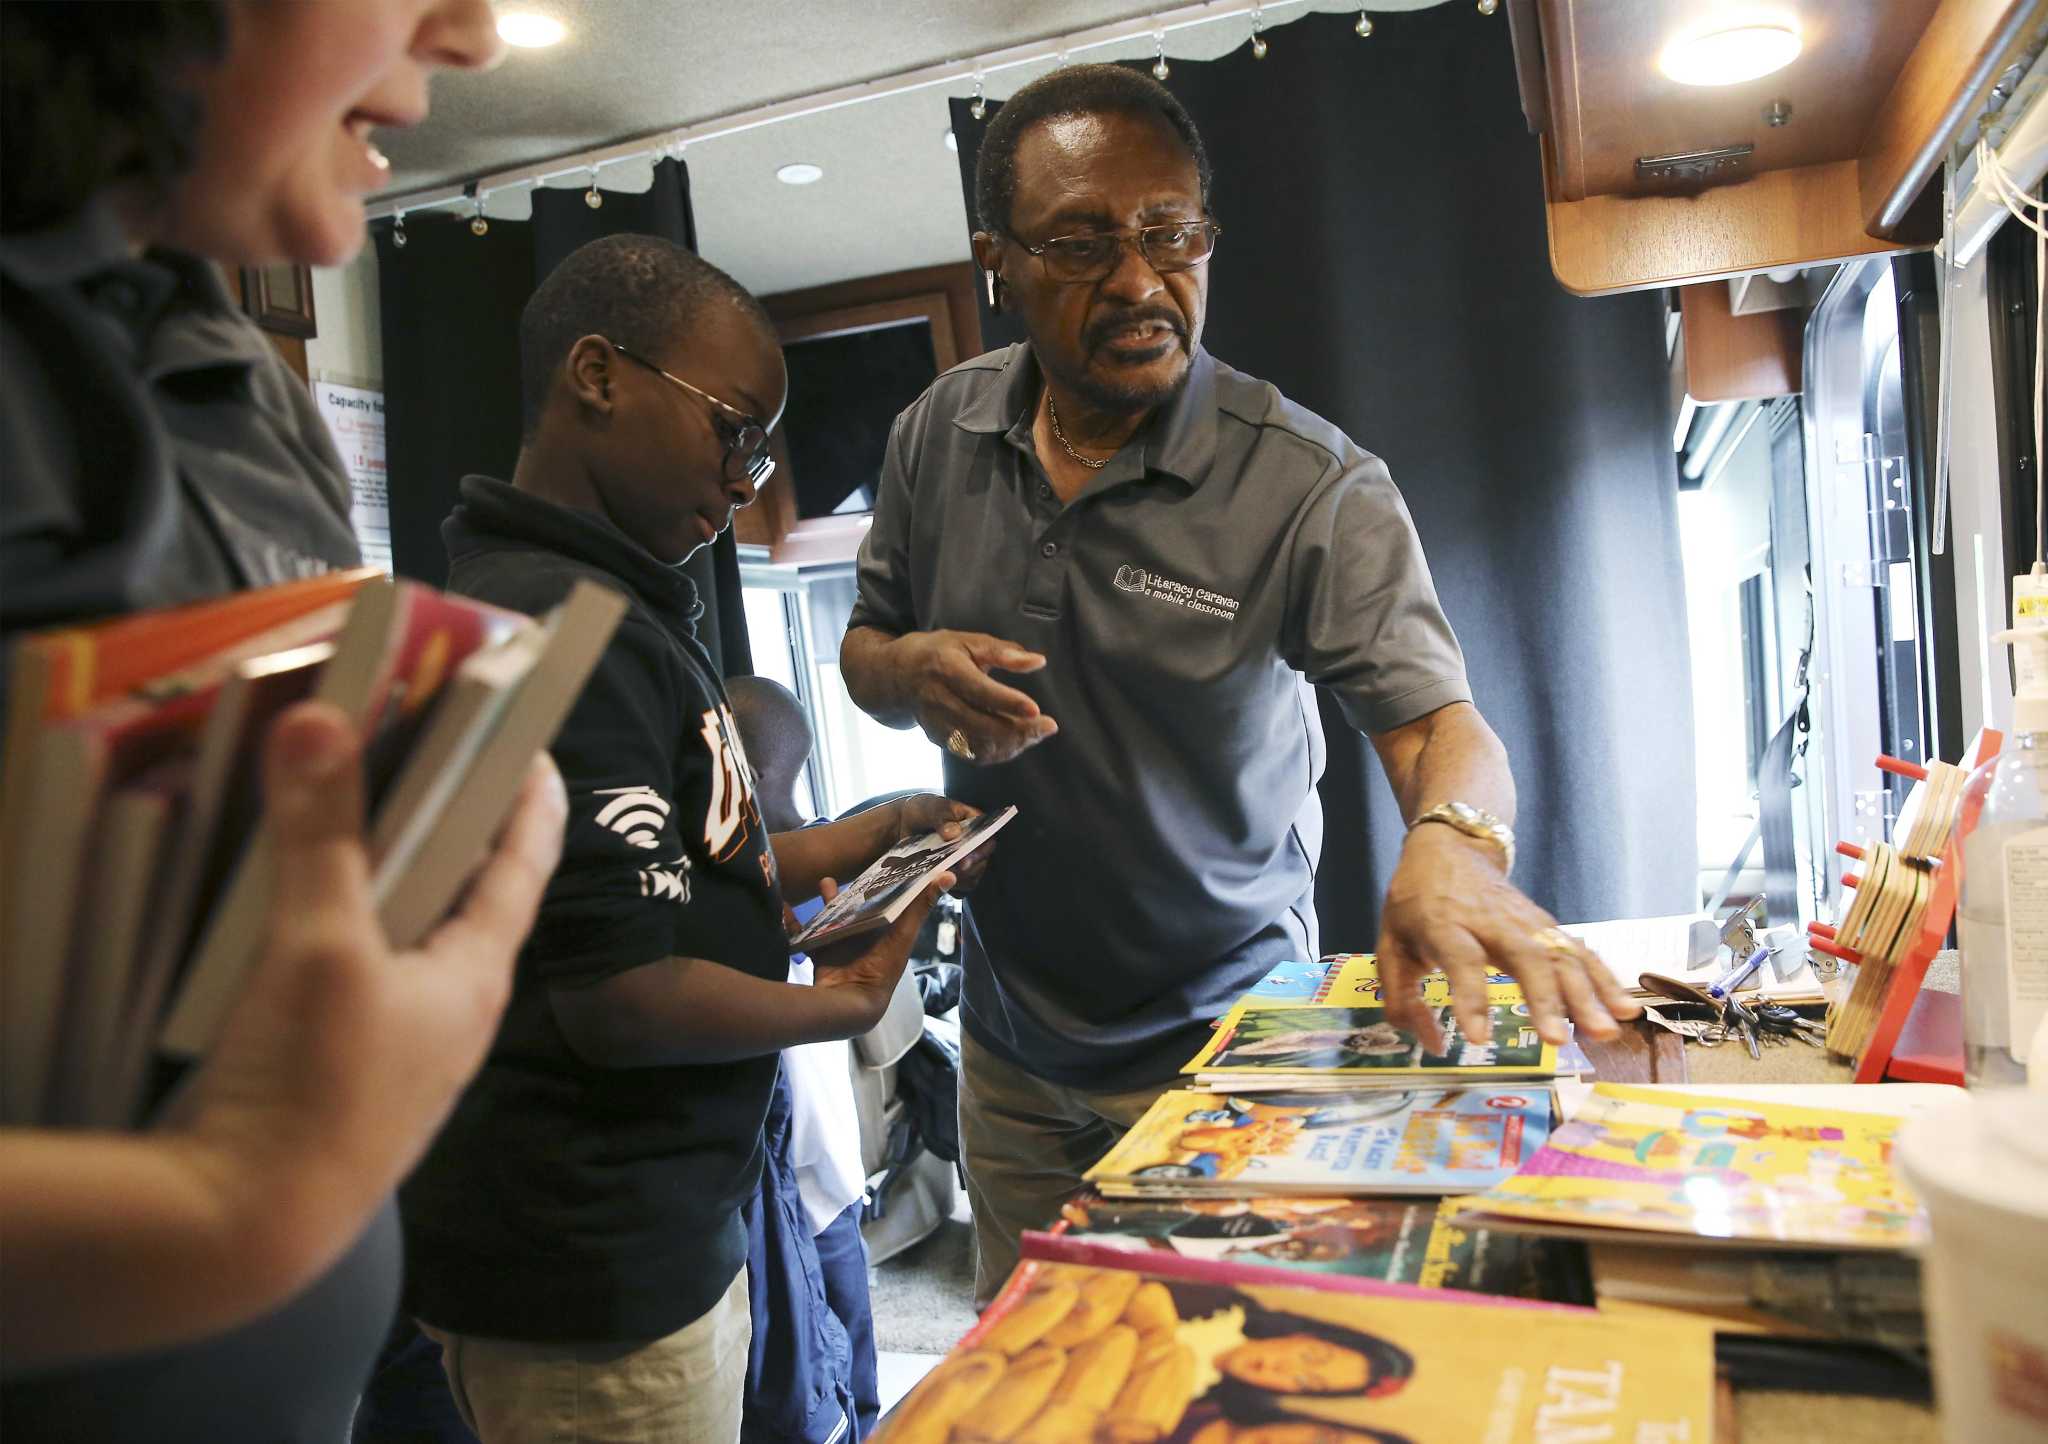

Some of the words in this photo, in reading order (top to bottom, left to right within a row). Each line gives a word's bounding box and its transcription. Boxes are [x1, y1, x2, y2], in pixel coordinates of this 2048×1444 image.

[328, 392, 370, 413] Capacity
[1144, 588, 1151, 596] a
[1153, 590, 1185, 605] mobile
[1187, 599, 1235, 620] classroom
[1147, 573, 1194, 598] Literacy
[1196, 588, 1239, 611] Caravan
